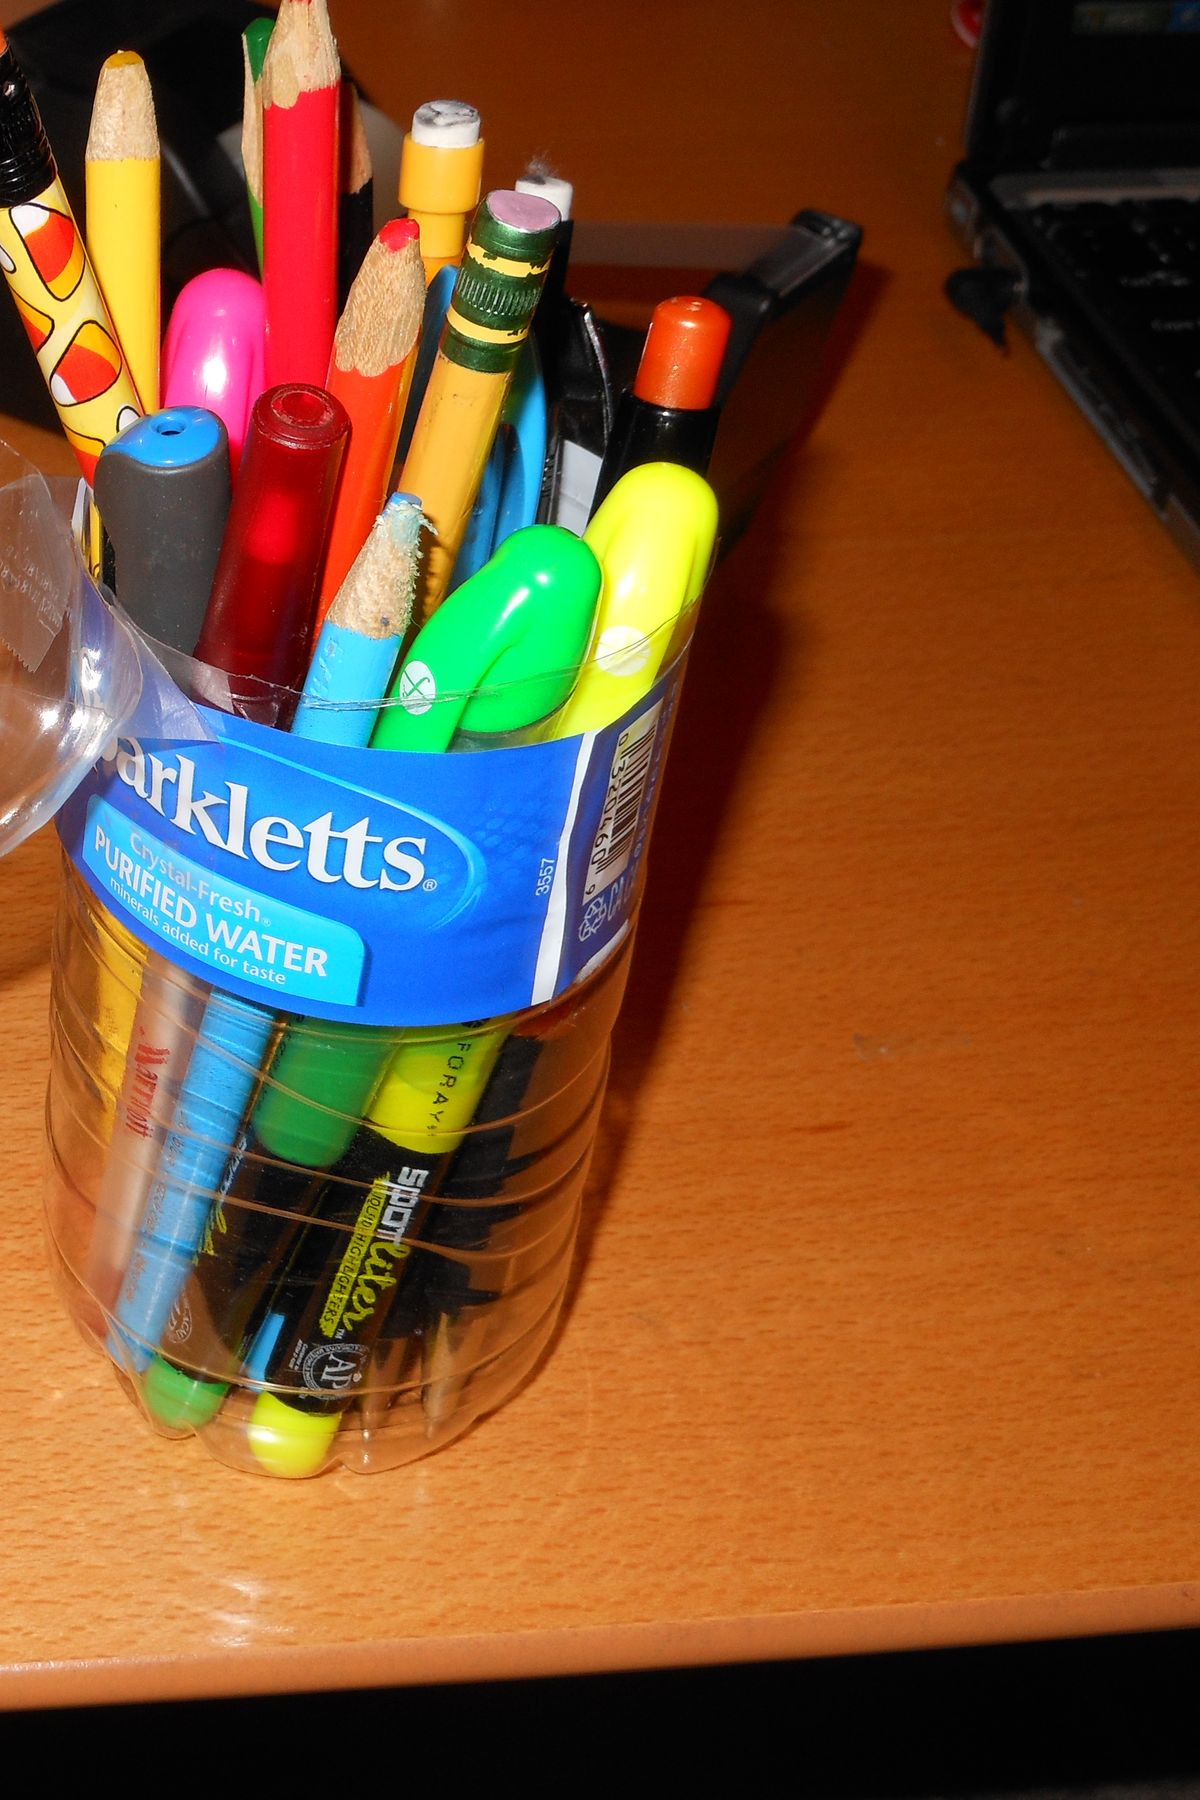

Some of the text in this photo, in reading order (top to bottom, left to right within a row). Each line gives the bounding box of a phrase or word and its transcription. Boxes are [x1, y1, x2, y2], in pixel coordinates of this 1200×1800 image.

[95, 824, 329, 977] PURIFIED WATER
[129, 831, 261, 923] Crystal-Fresh
[535, 857, 556, 897] 3557
[110, 877, 287, 985] minerals added for taste
[429, 1042, 472, 1122] FORAY
[361, 1184, 387, 1229] IQUID
